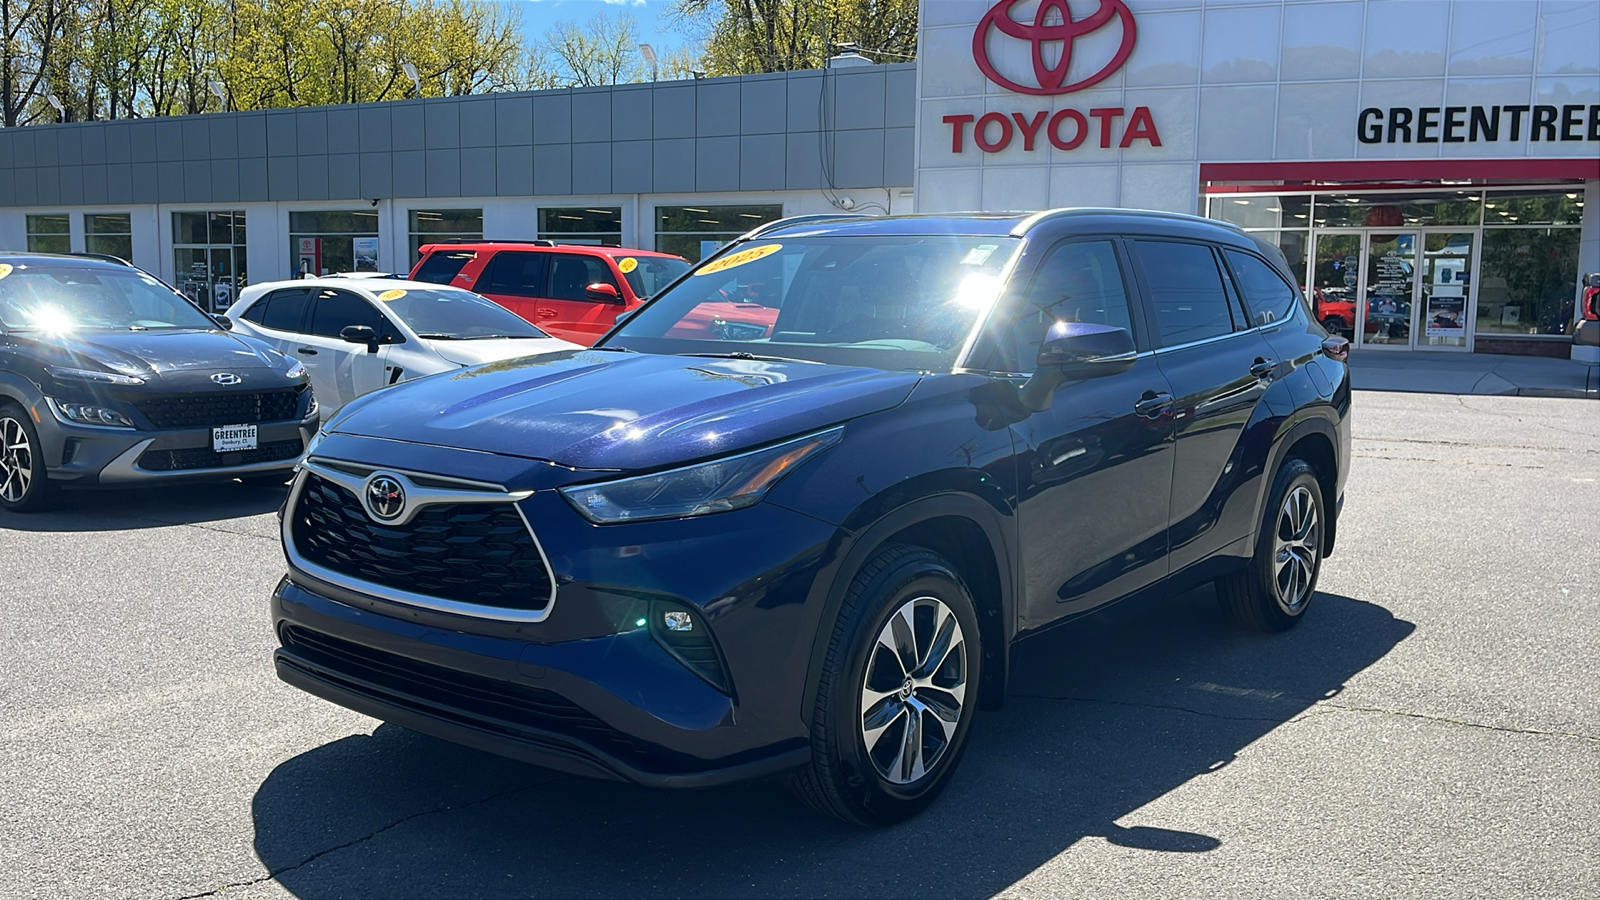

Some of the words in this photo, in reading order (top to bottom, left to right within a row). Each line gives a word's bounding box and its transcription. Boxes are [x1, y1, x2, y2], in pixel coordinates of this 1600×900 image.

[943, 106, 1162, 153] TOYOTA
[708, 246, 769, 272] 2025
[215, 429, 255, 440] GREENTREE
